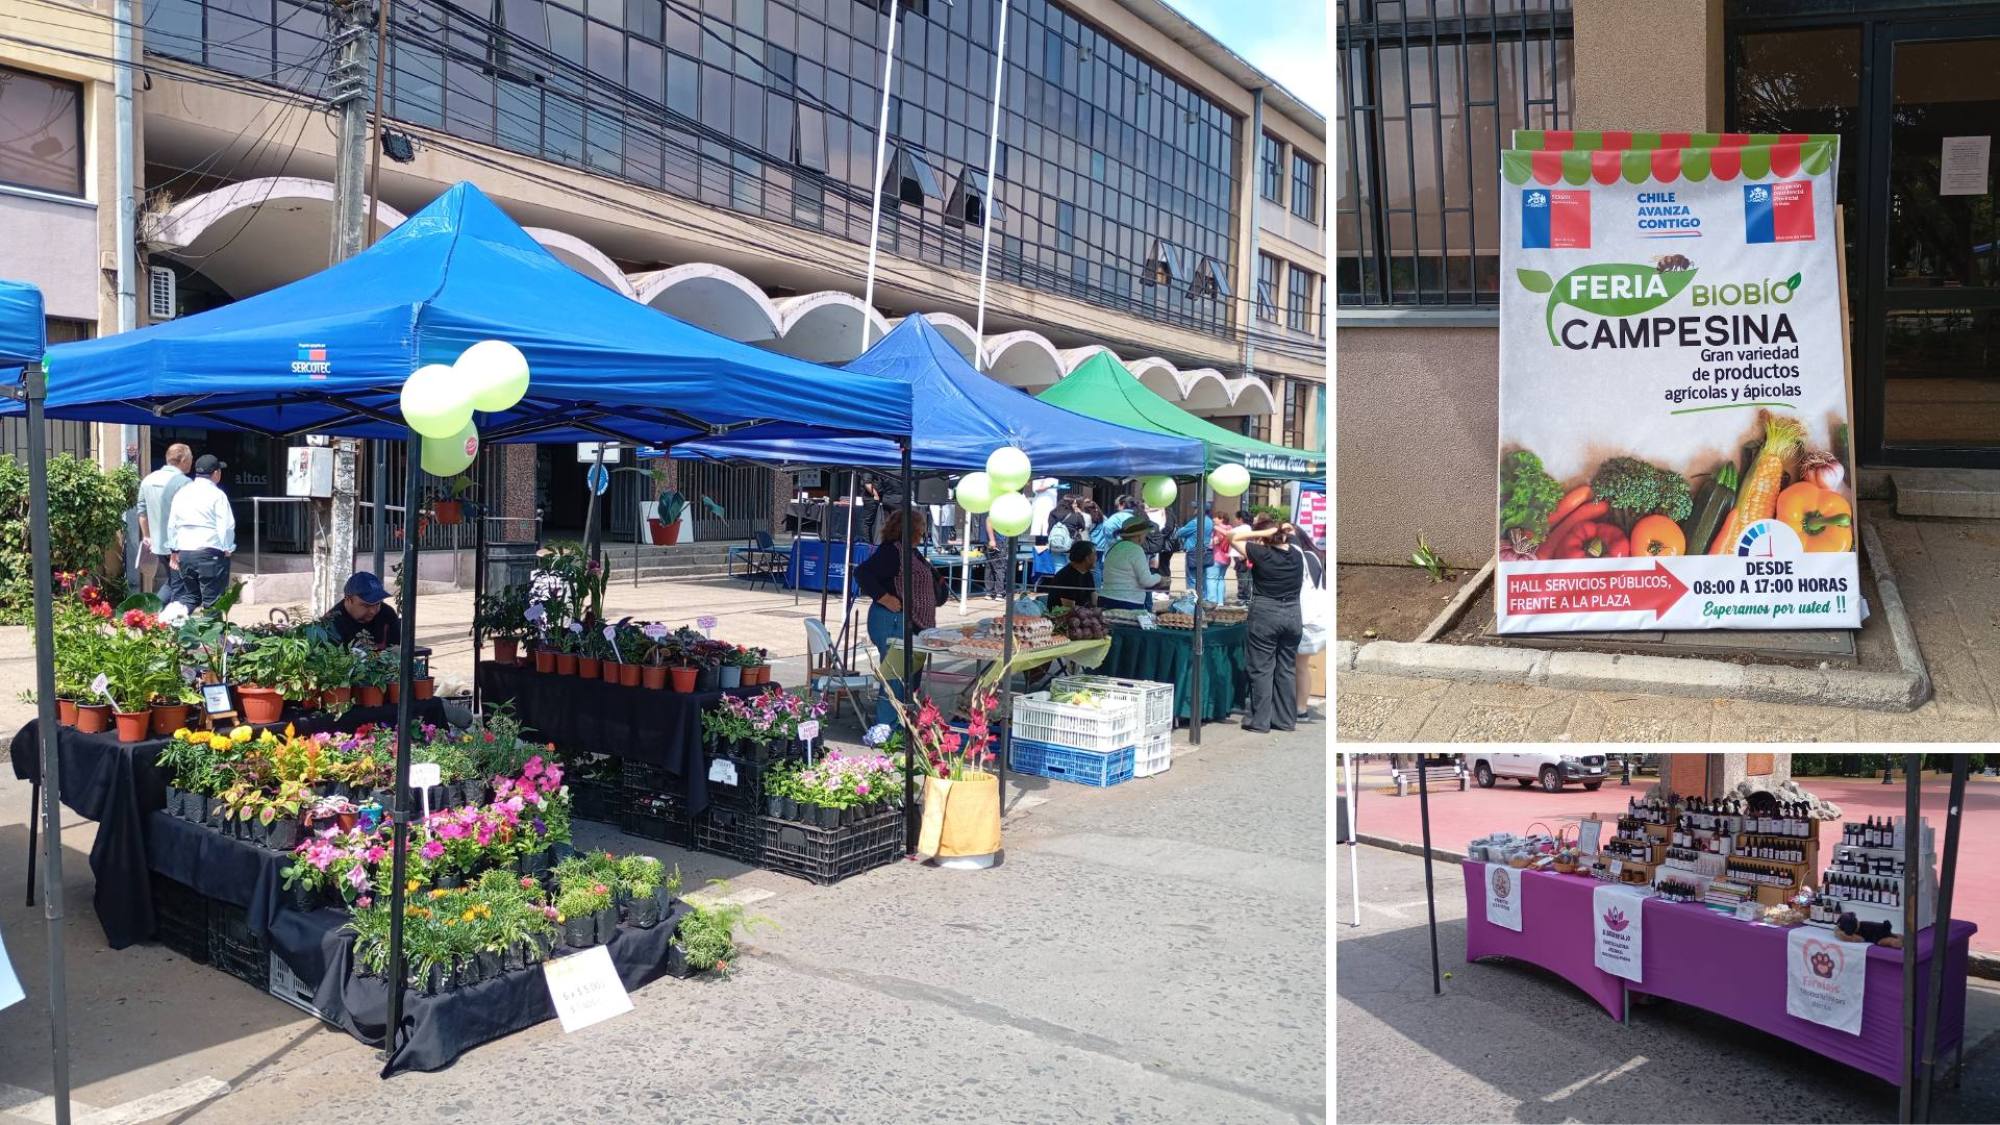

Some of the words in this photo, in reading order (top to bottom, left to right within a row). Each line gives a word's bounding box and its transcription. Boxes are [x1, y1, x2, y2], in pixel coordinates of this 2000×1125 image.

[1637, 192, 1675, 203] CHILE
[1638, 205, 1690, 216] AVANZA
[1638, 218, 1700, 228] CONTIGO
[1570, 273, 1669, 300] FERIA
[1691, 278, 1794, 307] BIOBÍO
[1561, 313, 1798, 350] CAMPESINA
[1701, 349, 1733, 362] Gran
[1737, 346, 1799, 361] variedad
[291, 362, 331, 373] SERCOTEC
[1692, 368, 1710, 381] de
[1715, 363, 1800, 384] productos
[1665, 385, 1728, 403] agrícolas
[1731, 388, 1739, 401] y
[1743, 383, 1802, 400] ápicolas
[1746, 561, 1794, 576] DESDE
[1510, 580, 1542, 593] HALL
[1545, 578, 1607, 591] SERVICIOS
[1609, 574, 1672, 590] PÚBLICOS,
[1693, 580, 1735, 595] 08:00
[1740, 579, 1750, 593] A
[1754, 578, 1793, 593] 17:00
[1798, 577, 1848, 592] HORAS
[1510, 597, 1557, 610] FRENTE
[1560, 597, 1569, 608] A
[1573, 597, 1588, 608] LA
[1591, 594, 1631, 607] PLAZA
[1703, 600, 1770, 619] Esperamos
[1773, 603, 1796, 618] por
[1798, 600, 1831, 614] usted
[1836, 595, 1847, 613] !!
